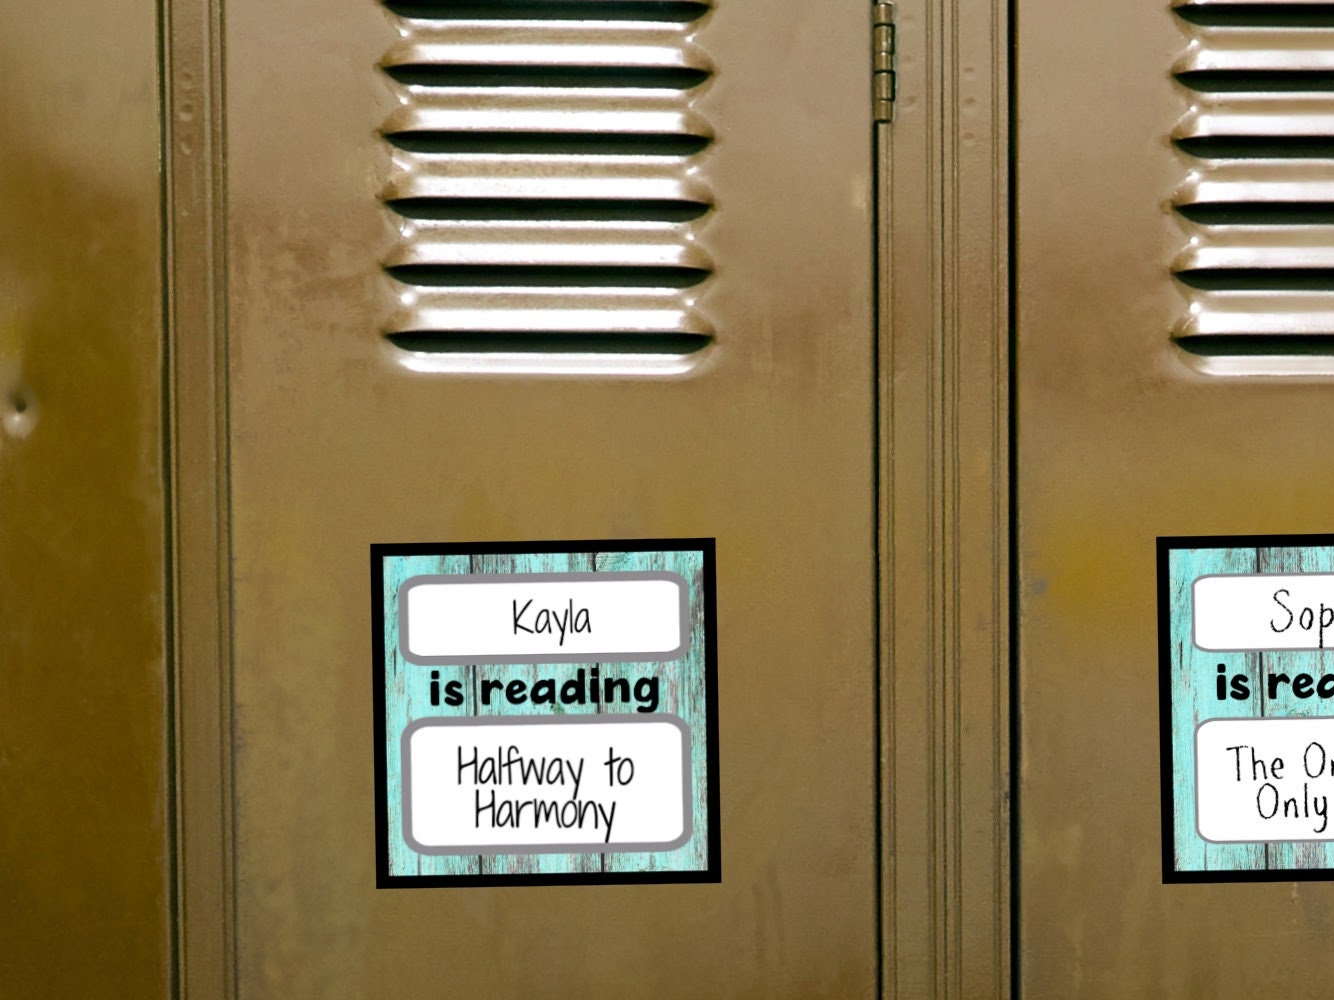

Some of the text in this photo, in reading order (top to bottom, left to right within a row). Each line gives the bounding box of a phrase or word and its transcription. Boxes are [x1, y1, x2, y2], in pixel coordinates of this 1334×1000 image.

[512, 599, 592, 647] Kayla
[430, 665, 659, 714] is reading
[1216, 663, 1250, 701] is
[457, 745, 634, 801] Halfway to
[1226, 745, 1284, 783] The
[475, 789, 616, 843] Harmony
[1256, 780, 1328, 835] Only
